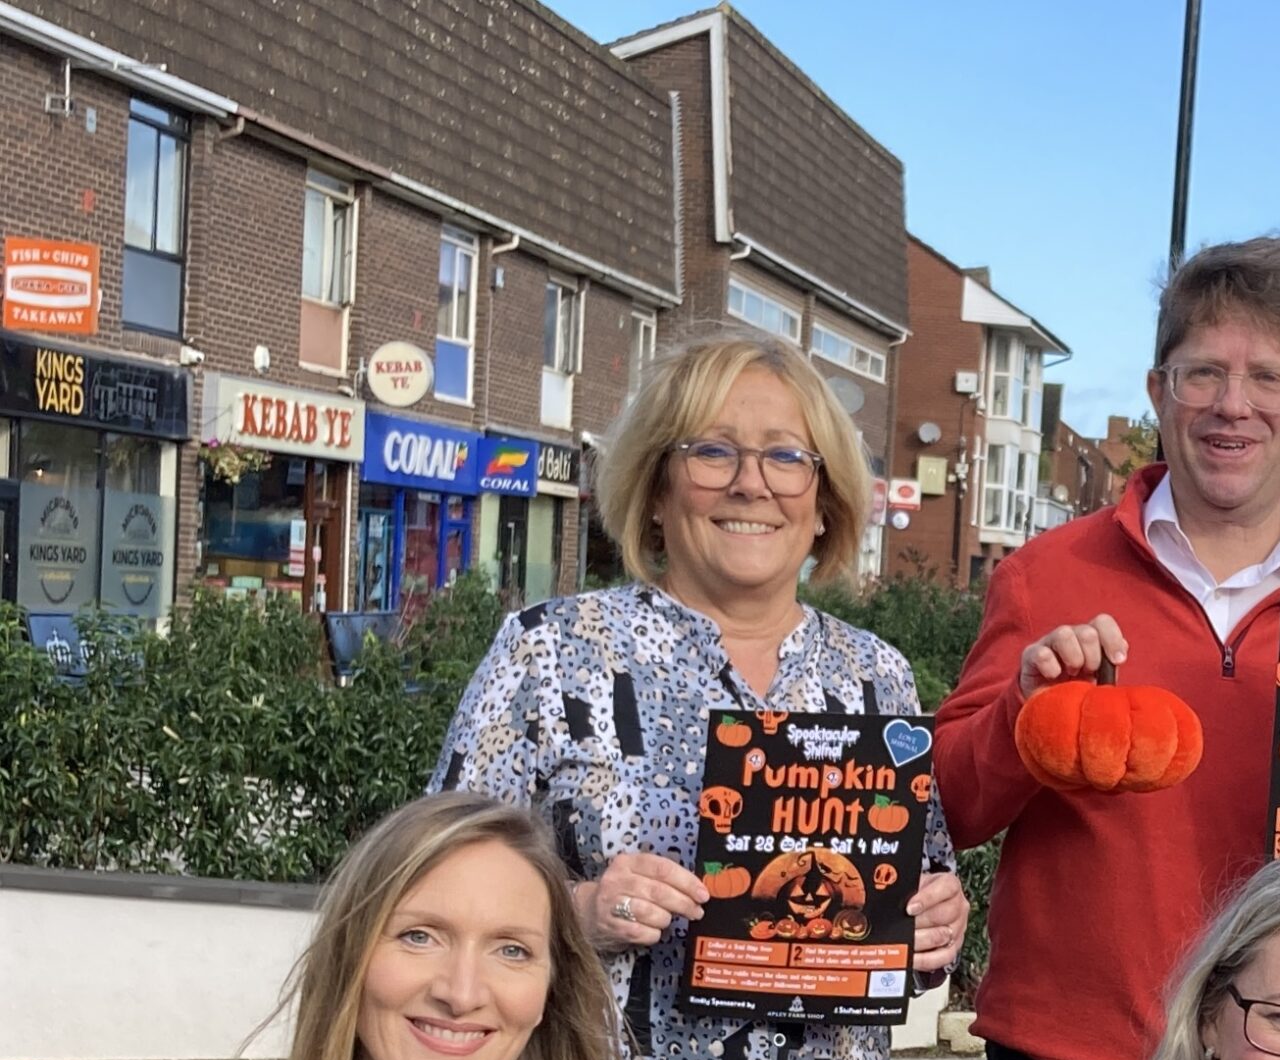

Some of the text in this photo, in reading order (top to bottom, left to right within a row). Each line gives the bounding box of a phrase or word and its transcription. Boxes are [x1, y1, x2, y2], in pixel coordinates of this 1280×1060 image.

[12, 248, 40, 263] FISH
[52, 250, 90, 268] CHIPS
[12, 307, 84, 325] TAKEAWAY
[36, 348, 84, 386] KINGS
[375, 360, 423, 375] KEBAB
[391, 377, 410, 390] YE
[35, 378, 85, 416] YARD
[239, 393, 353, 449] KEBAB YE
[383, 430, 460, 482] CORAL
[480, 477, 530, 493] CORAL
[30, 544, 87, 564] KINGS YARD
[112, 550, 164, 567] KINGS YARD
[787, 723, 861, 747] Spooktacular
[803, 741, 843, 762] Shifnal
[742, 747, 897, 799] Pumpkin
[755, 836, 774, 852] 28
[858, 838, 865, 852] 4
[794, 946, 802, 961] 2
[695, 965, 705, 981] 3
